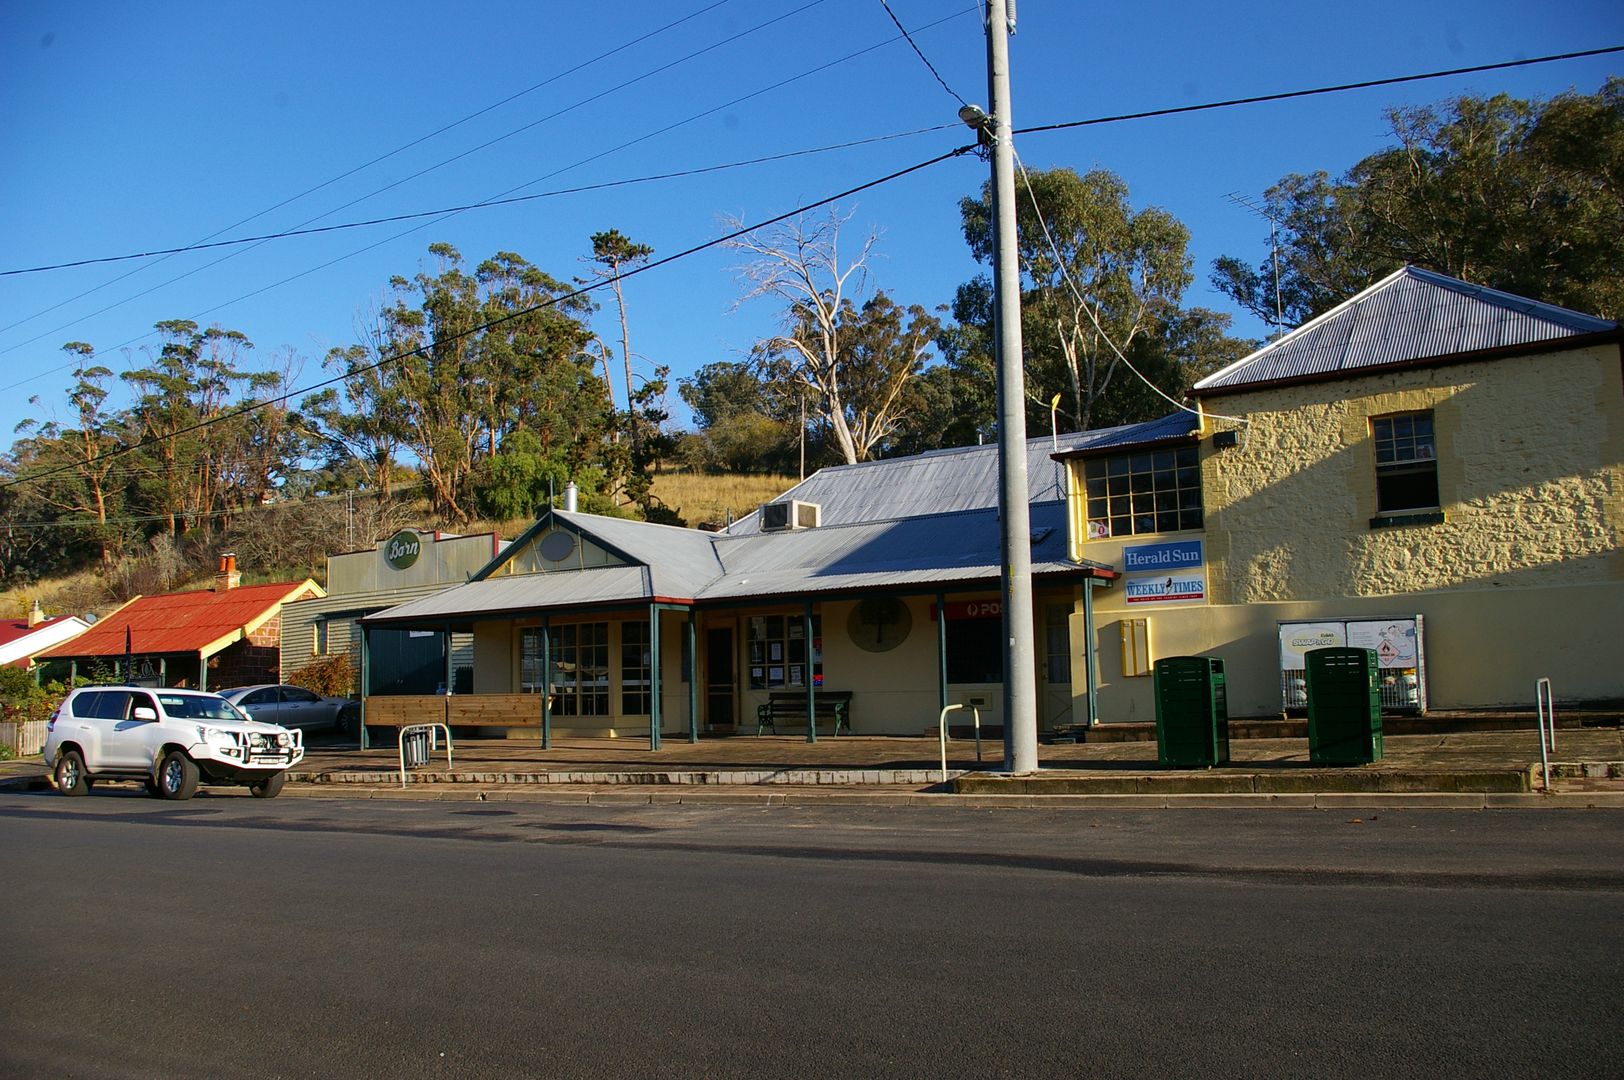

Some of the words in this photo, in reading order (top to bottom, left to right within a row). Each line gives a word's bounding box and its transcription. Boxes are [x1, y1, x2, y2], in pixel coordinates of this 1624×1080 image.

[389, 540, 418, 560] Barn
[1127, 550, 1171, 566] Herald
[1173, 549, 1200, 562] Sun
[1127, 584, 1165, 596] WEEKLY
[1173, 581, 1204, 593] TIMES
